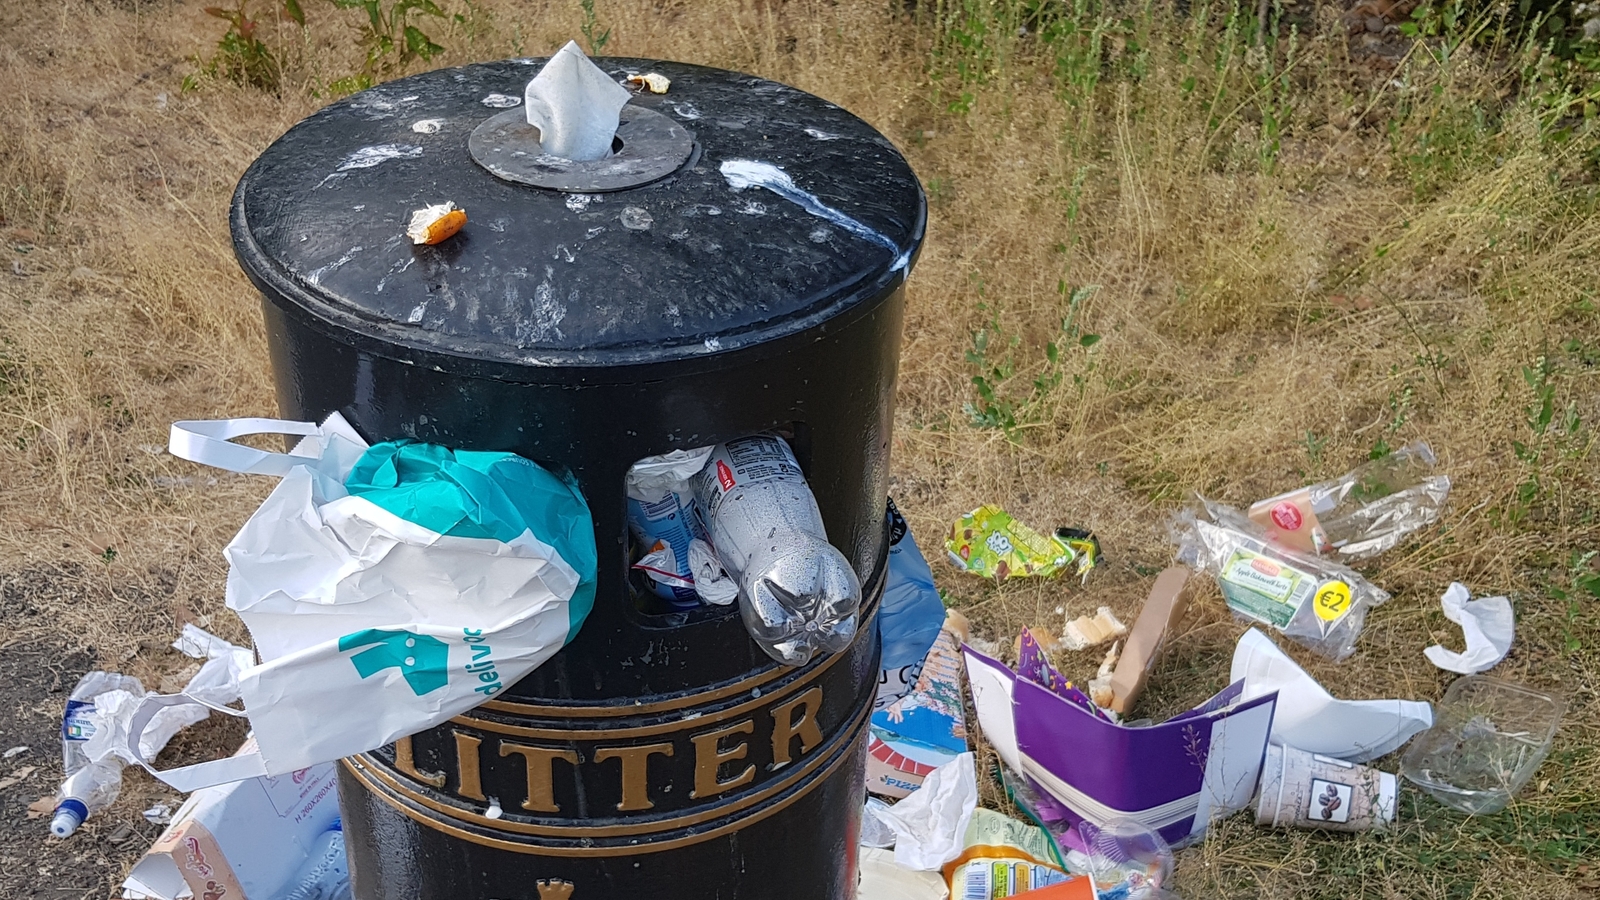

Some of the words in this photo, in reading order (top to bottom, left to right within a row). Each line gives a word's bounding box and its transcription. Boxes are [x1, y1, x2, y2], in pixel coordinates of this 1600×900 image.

[1236, 567, 1250, 577] Apple
[1251, 571, 1275, 586] Bakewell
[1276, 581, 1288, 590] Tarts
[1320, 591, 1345, 612] €2
[394, 685, 824, 813] LITTER
[885, 777, 921, 792] PIZZ
[295, 814, 302, 824] H
